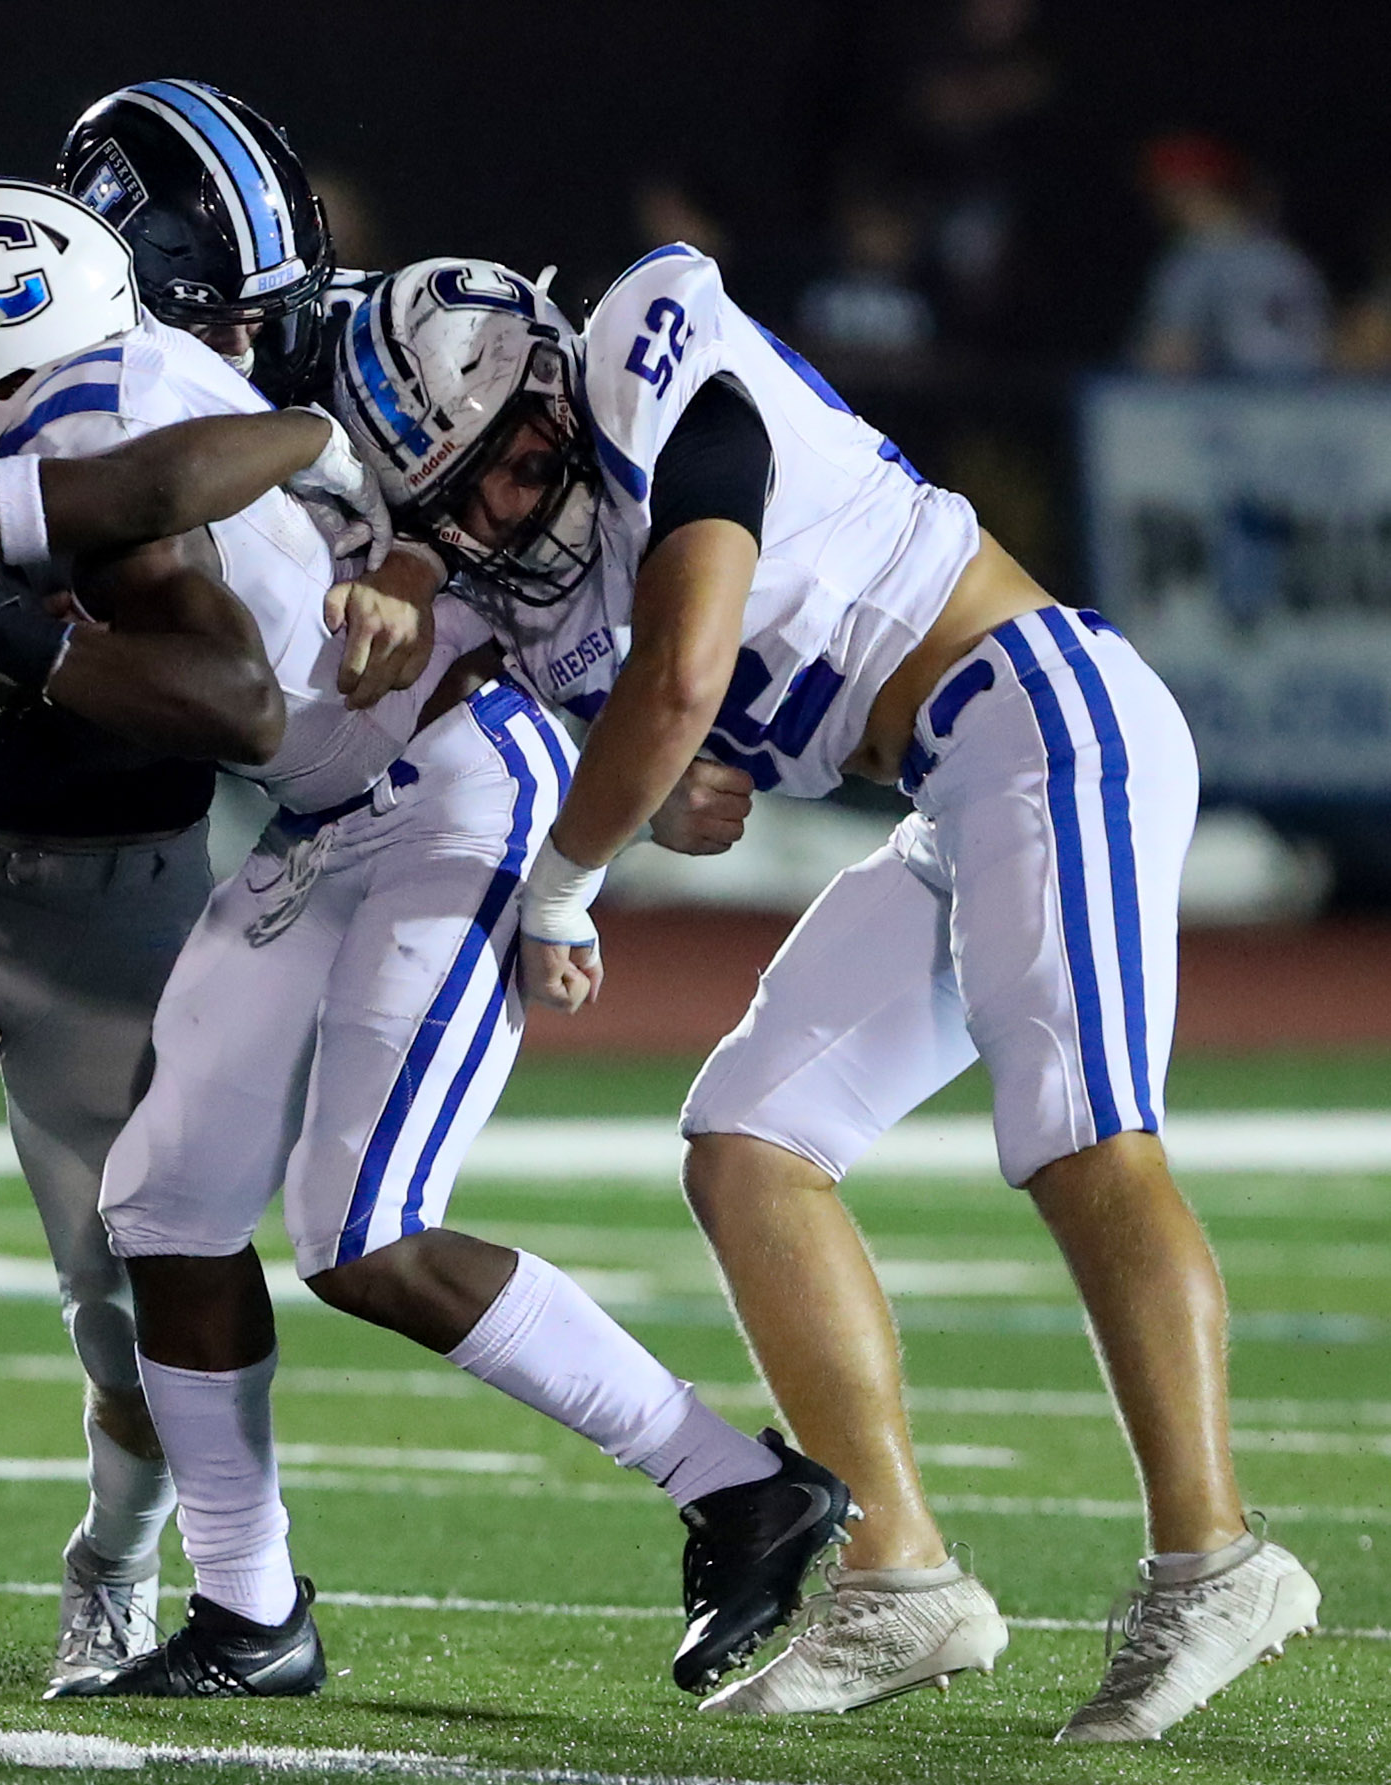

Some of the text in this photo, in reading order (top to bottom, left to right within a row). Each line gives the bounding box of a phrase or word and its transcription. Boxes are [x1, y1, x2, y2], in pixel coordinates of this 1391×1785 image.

[103, 144, 143, 202] HUSKIES
[625, 297, 694, 400] 52
[410, 440, 456, 487] Riddell
